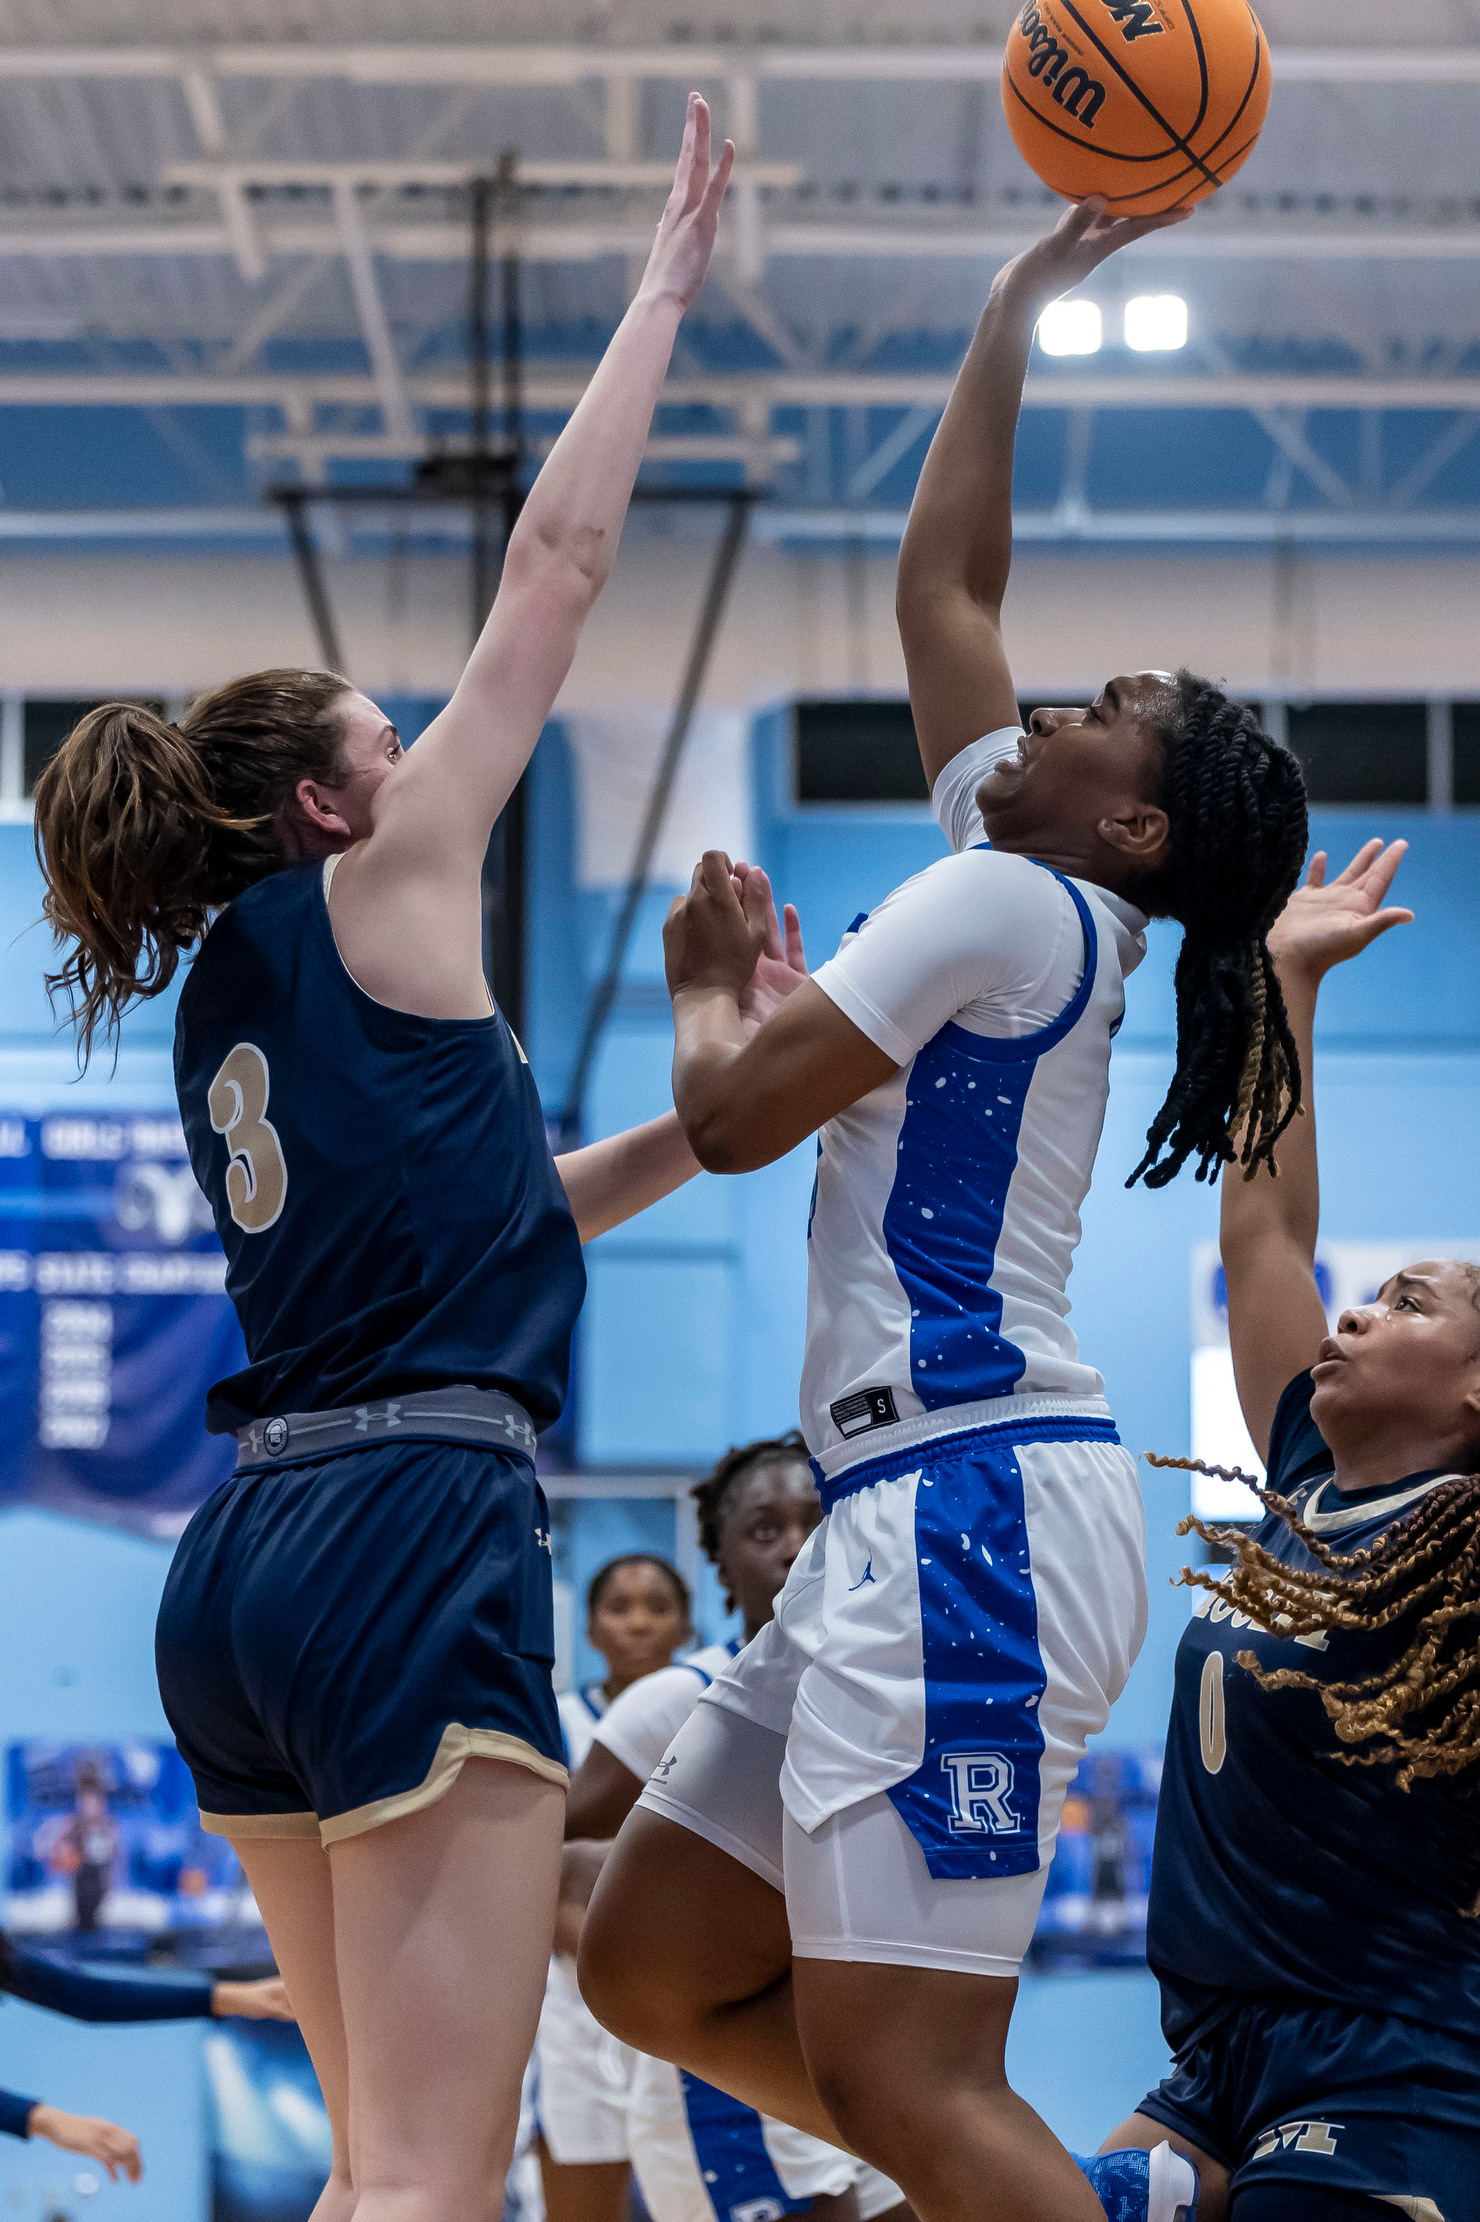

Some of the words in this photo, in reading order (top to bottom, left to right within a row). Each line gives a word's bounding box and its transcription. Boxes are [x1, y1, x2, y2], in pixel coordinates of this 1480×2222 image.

[208, 1042, 288, 1234] 3
[877, 1398, 886, 1414] S
[1199, 1650, 1226, 1775] 0
[941, 1752, 1020, 1835] R
